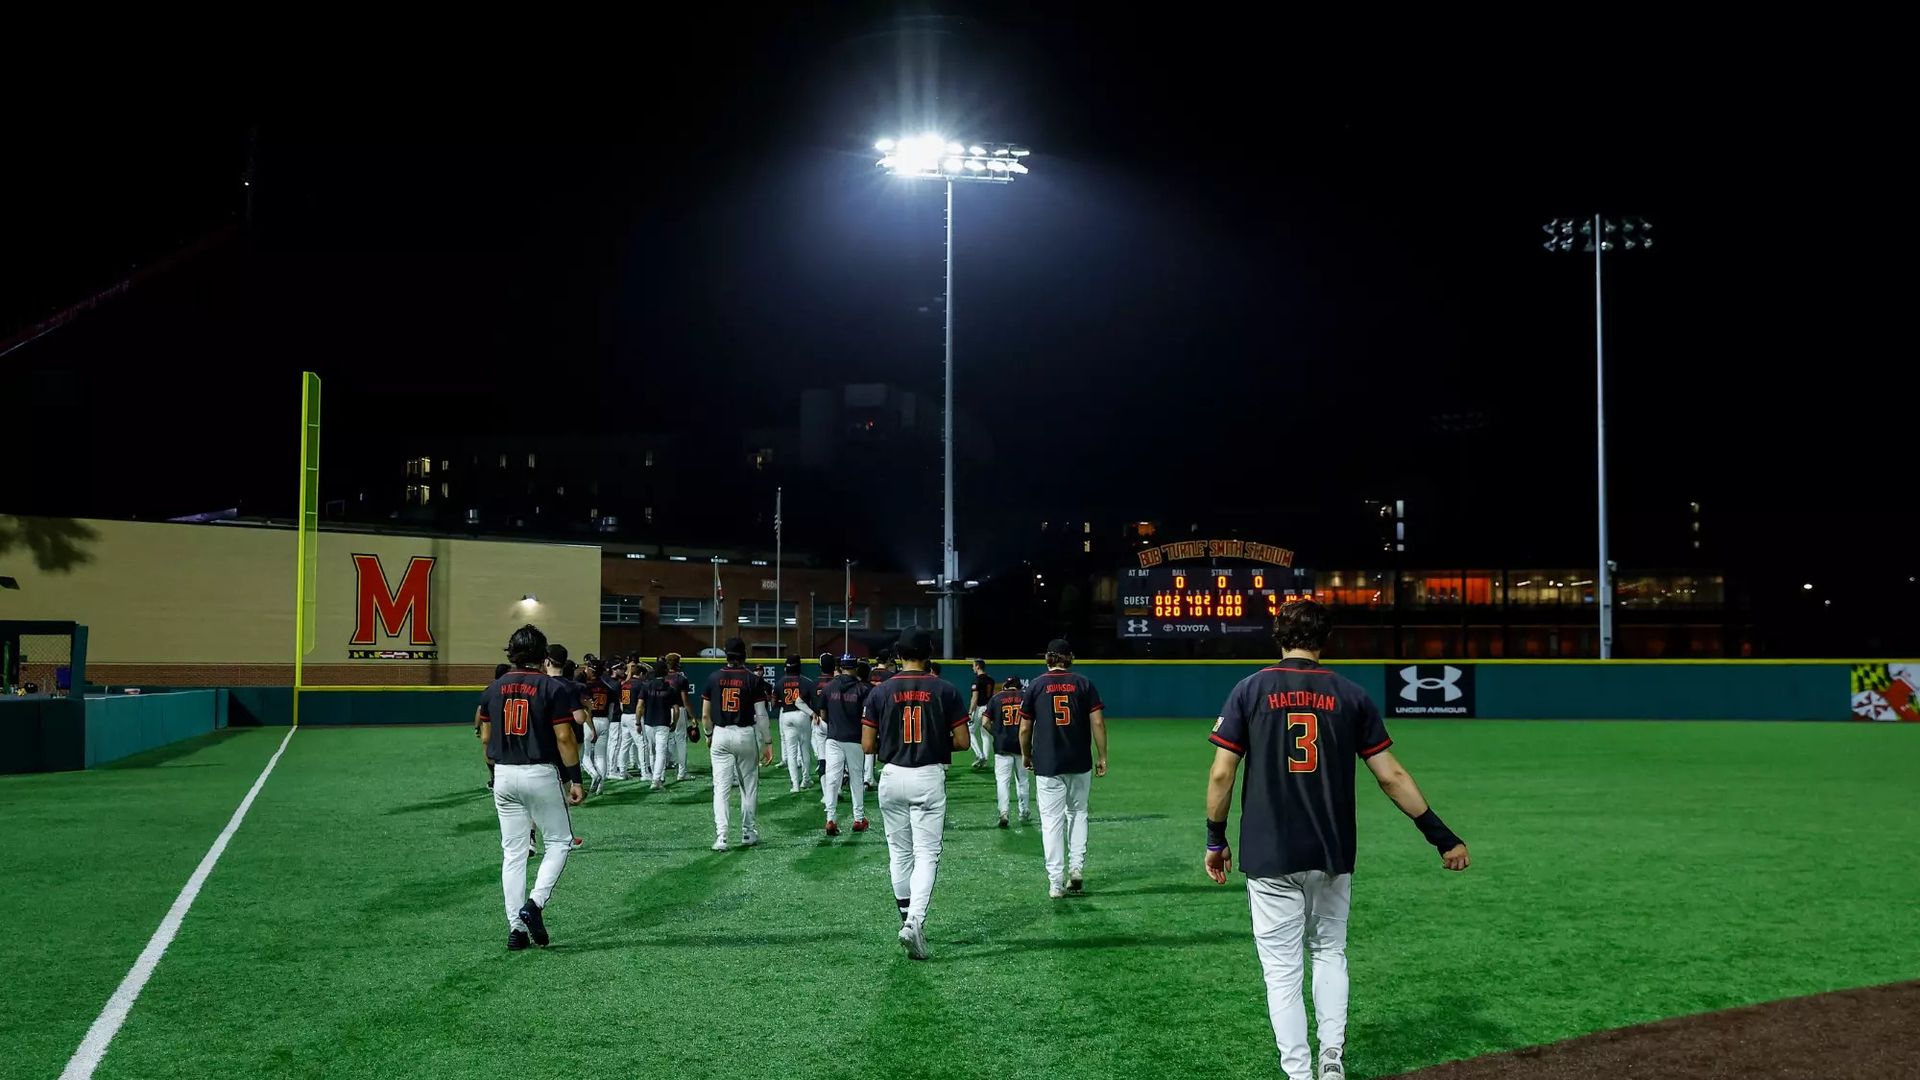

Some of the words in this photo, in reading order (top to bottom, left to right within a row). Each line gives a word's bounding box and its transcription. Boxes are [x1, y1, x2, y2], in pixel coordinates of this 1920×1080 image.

[1209, 540, 1244, 558] SMITH
[1244, 542, 1294, 568] STADIUM
[1128, 569, 1136, 577] AT
[1138, 569, 1150, 577] BAT
[1172, 569, 1187, 577] BALL
[1211, 569, 1233, 577] STRIKE
[1176, 576, 1184, 589] 0
[1218, 576, 1227, 589] 0
[1254, 576, 1263, 589] 0
[348, 553, 437, 645] M
[1124, 596, 1150, 605] GUEST
[1175, 624, 1210, 632] TOYOTA
[784, 688, 800, 705] 24
[1045, 683, 1077, 693] JOHNSON
[721, 687, 741, 712] 15
[1268, 691, 1335, 711] HACOPIAN
[503, 698, 529, 736] 10
[1002, 704, 1022, 726] 37
[1053, 695, 1071, 726] 5
[903, 706, 922, 743] 11
[1287, 713, 1318, 773] 3
